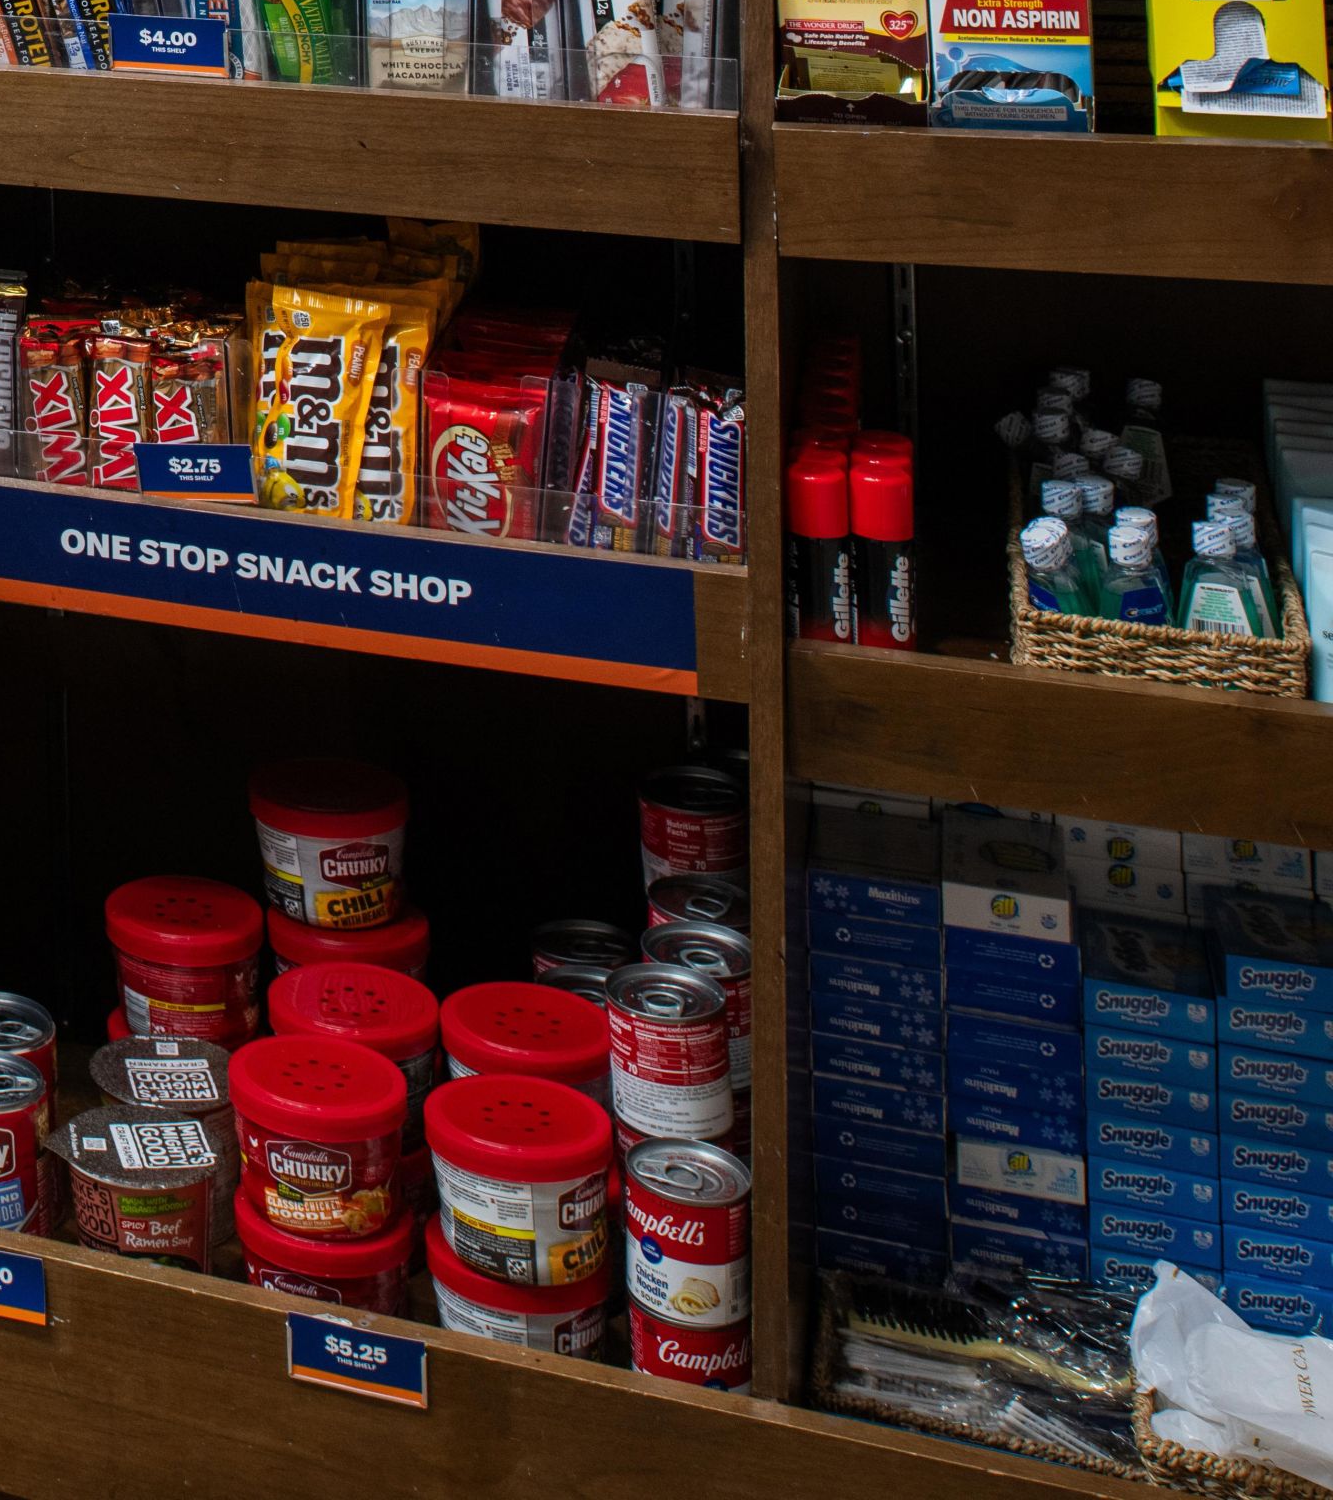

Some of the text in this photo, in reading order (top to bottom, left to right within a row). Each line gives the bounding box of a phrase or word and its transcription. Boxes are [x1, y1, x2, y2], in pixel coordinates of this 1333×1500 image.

[953, 8, 1081, 30] NON ASPIRIN
[139, 28, 197, 47] $4.00
[168, 457, 222, 475] $2.75
[705, 413, 741, 547] SNICKERS
[59, 528, 472, 606] ONE STOP SNACK SHOP
[269, 1151, 347, 1184] CHUNKY
[1237, 1238, 1313, 1266] Snuggle
[324, 1334, 388, 1364] $5.25
